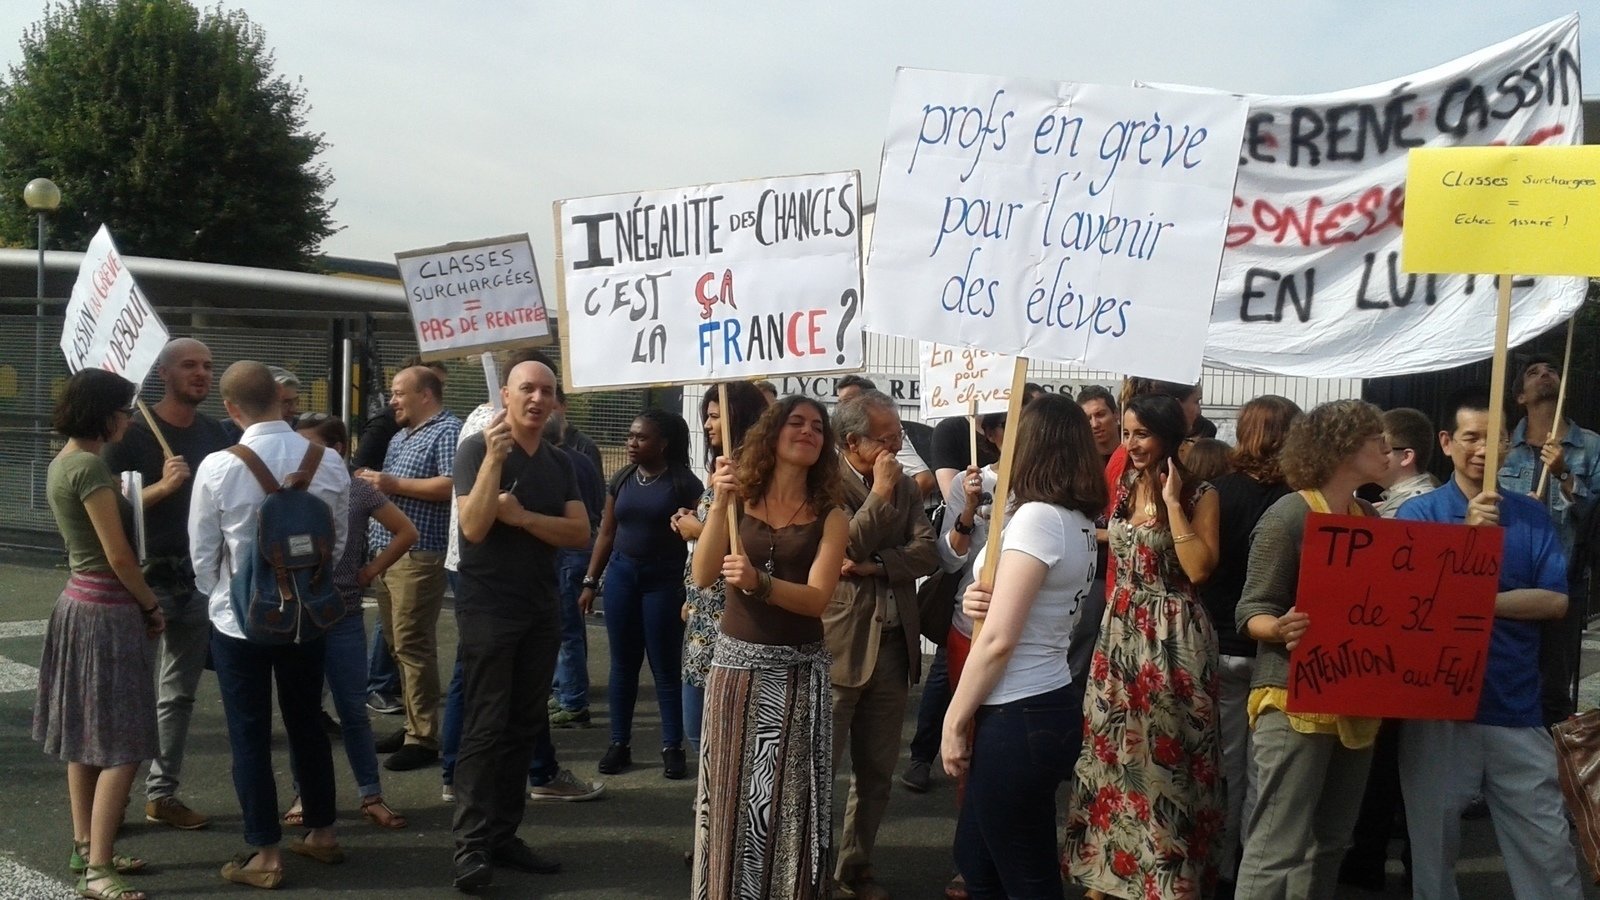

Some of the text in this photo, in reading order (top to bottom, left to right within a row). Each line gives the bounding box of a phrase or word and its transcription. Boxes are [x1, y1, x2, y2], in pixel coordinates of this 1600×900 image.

[1289, 82, 1425, 167] RENÉ
[1435, 42, 1582, 137] CASSIN
[908, 89, 1208, 197] profs en grève
[1442, 171, 1508, 187] Classes
[730, 211, 756, 232] DES
[755, 183, 856, 246] CHANCES
[928, 171, 1174, 261] pour l'avenir
[413, 269, 534, 303] SURCHARGÉES
[419, 249, 514, 279] CLASSES
[584, 268, 738, 322] C'EST ÇA
[941, 247, 1131, 338] des élèves
[1240, 267, 1316, 323] EN
[109, 282, 148, 371] DEBOUT
[420, 318, 454, 342] PAS
[459, 315, 479, 333] DE
[631, 324, 667, 364] LA
[698, 310, 827, 366] FRANCE
[931, 342, 953, 368] En
[954, 368, 989, 389] pour
[931, 386, 949, 407] les
[1318, 526, 1498, 601] TP à plus
[1348, 585, 1390, 627] de
[1401, 596, 1435, 632] 32
[1294, 639, 1396, 699] ATTENTION
[1402, 669, 1431, 688] au
